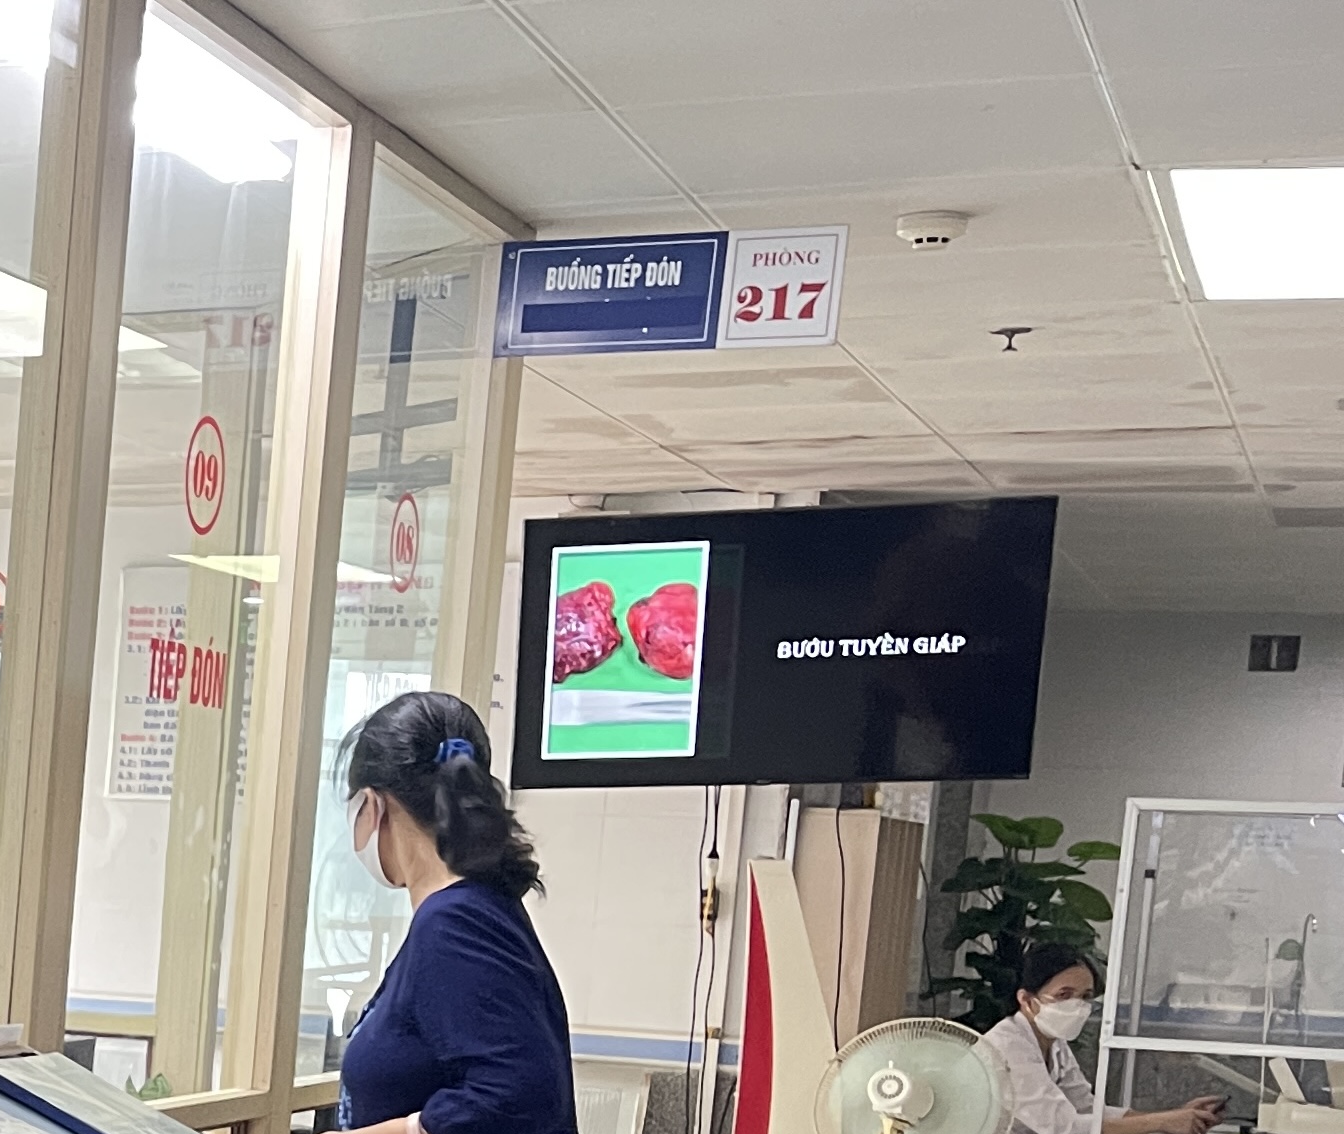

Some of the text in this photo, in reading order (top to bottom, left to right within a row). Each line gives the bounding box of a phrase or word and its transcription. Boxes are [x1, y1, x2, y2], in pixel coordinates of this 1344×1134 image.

[606, 253, 642, 289] TIẾP
[645, 256, 682, 287] ĐÓN
[751, 247, 820, 268] PHÒNG
[734, 280, 829, 323] 217
[193, 450, 218, 502] 09
[912, 632, 967, 655] GIÁP
[149, 627, 227, 709] TIẾP ĐÓN
